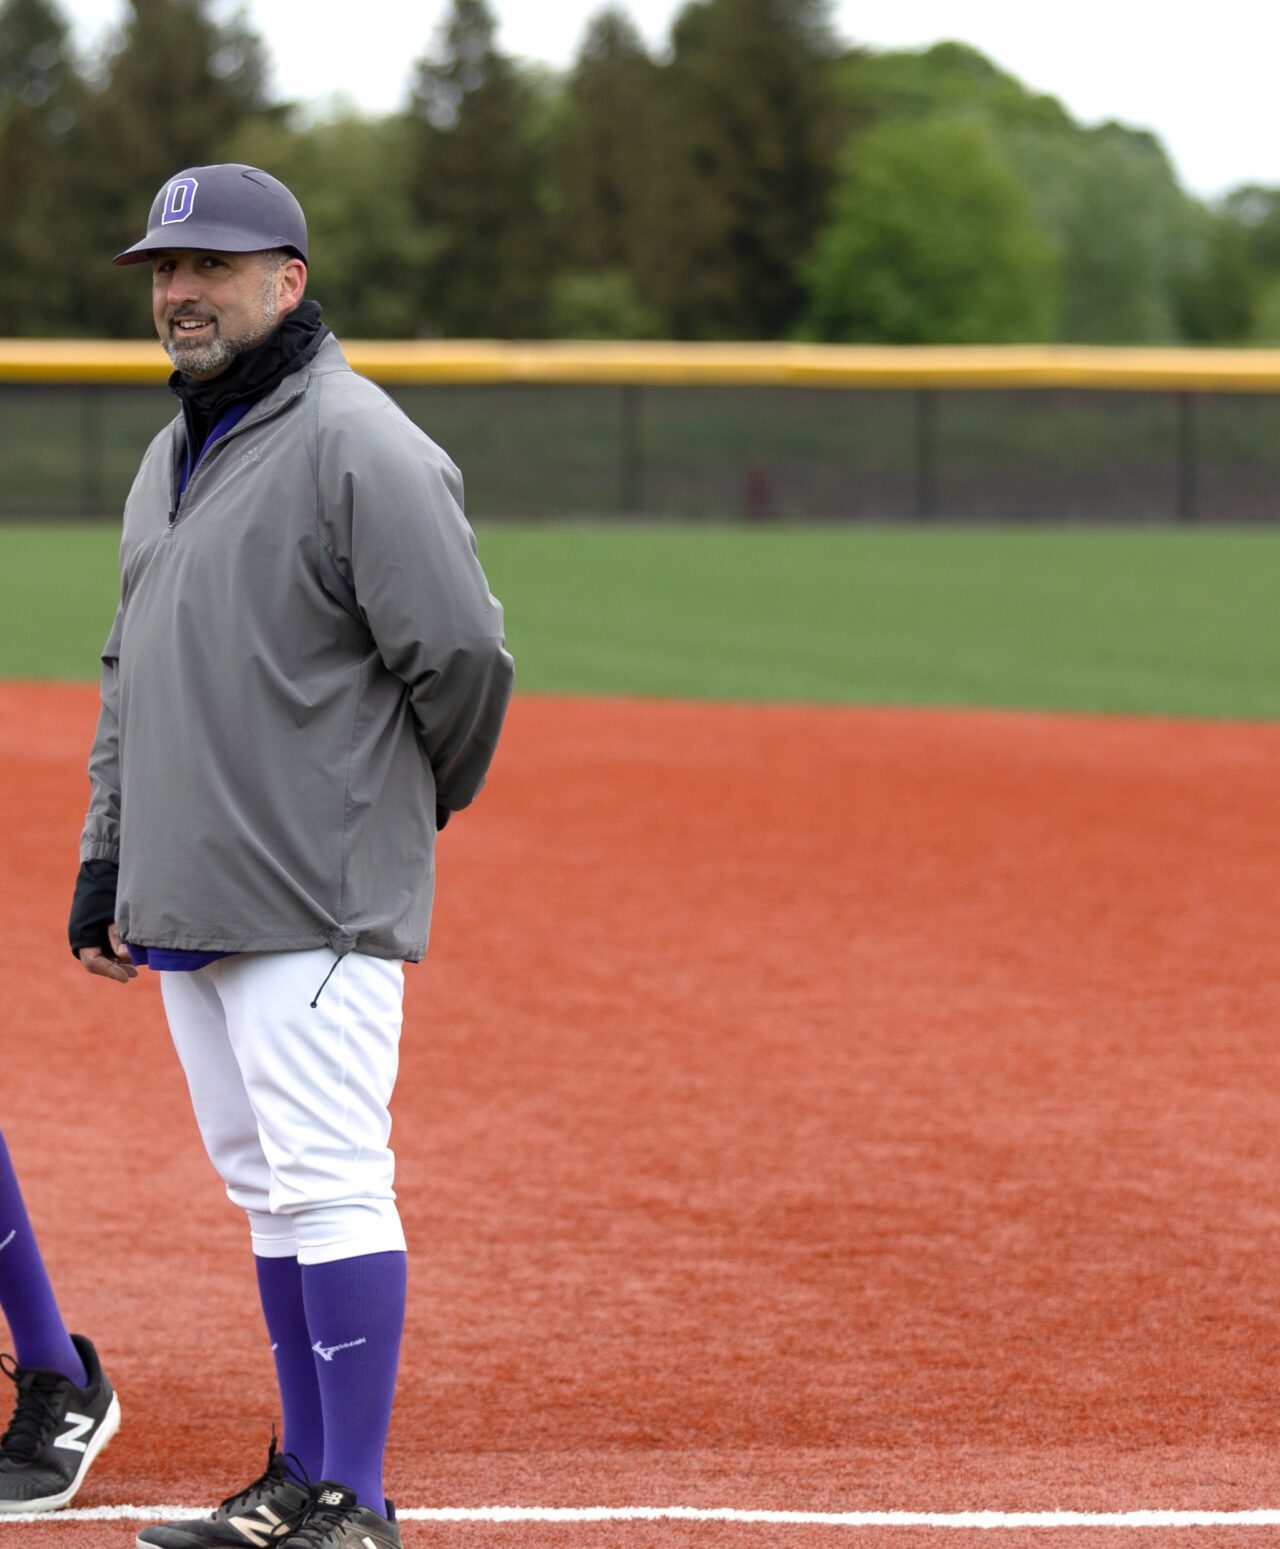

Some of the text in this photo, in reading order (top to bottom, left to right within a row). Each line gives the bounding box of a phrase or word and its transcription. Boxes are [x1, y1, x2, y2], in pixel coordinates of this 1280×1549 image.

[162, 178, 198, 225] D
[53, 1411, 95, 1453] N
[228, 1504, 291, 1548] N
